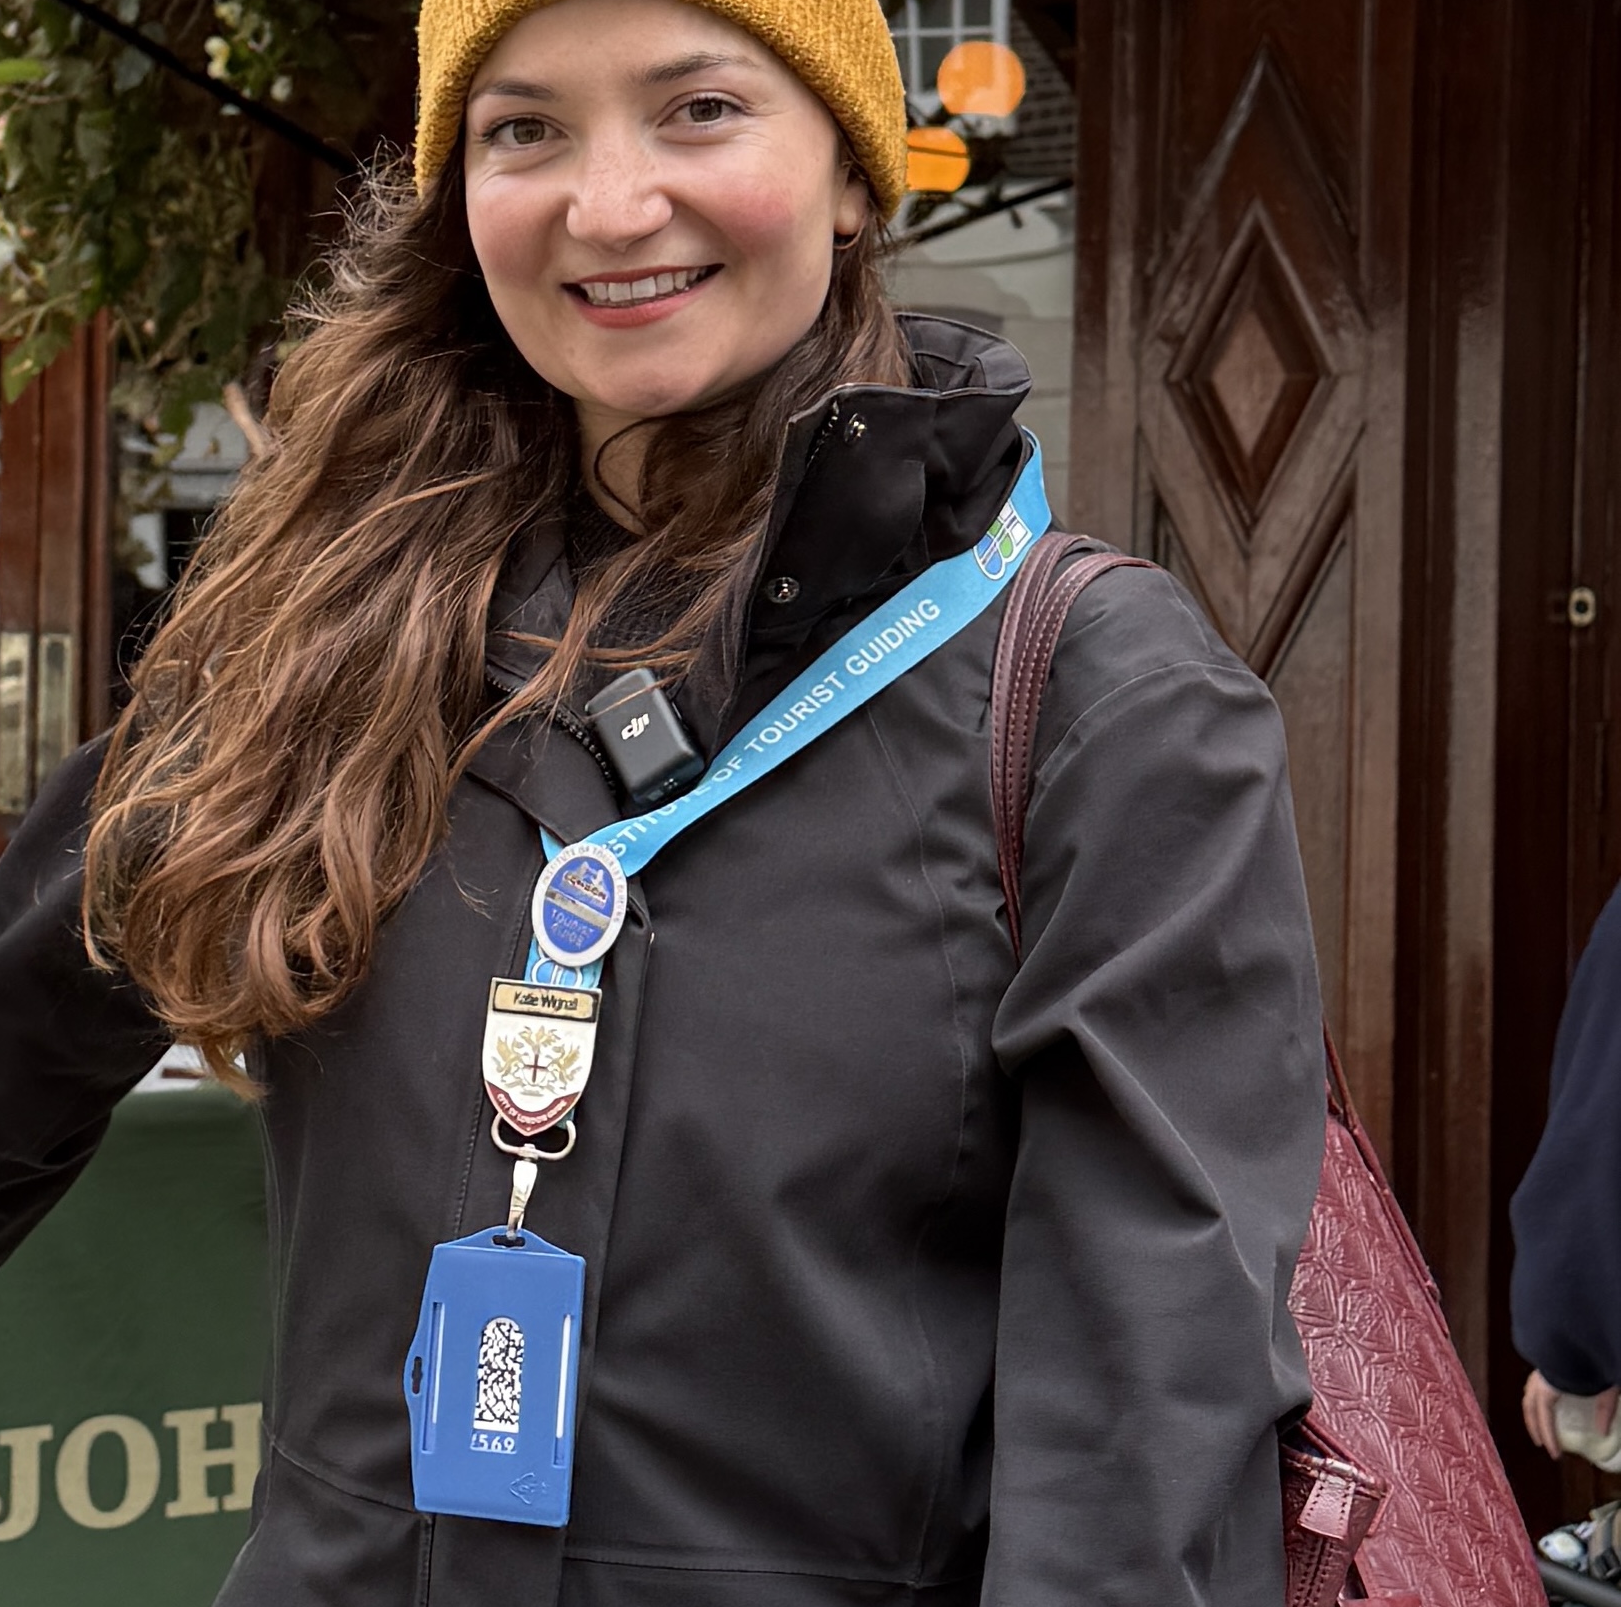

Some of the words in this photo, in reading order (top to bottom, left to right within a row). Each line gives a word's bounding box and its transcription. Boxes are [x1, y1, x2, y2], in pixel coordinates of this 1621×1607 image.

[712, 755, 742, 782] OF
[744, 671, 846, 754] TOURIST
[845, 599, 941, 676] GUIDING
